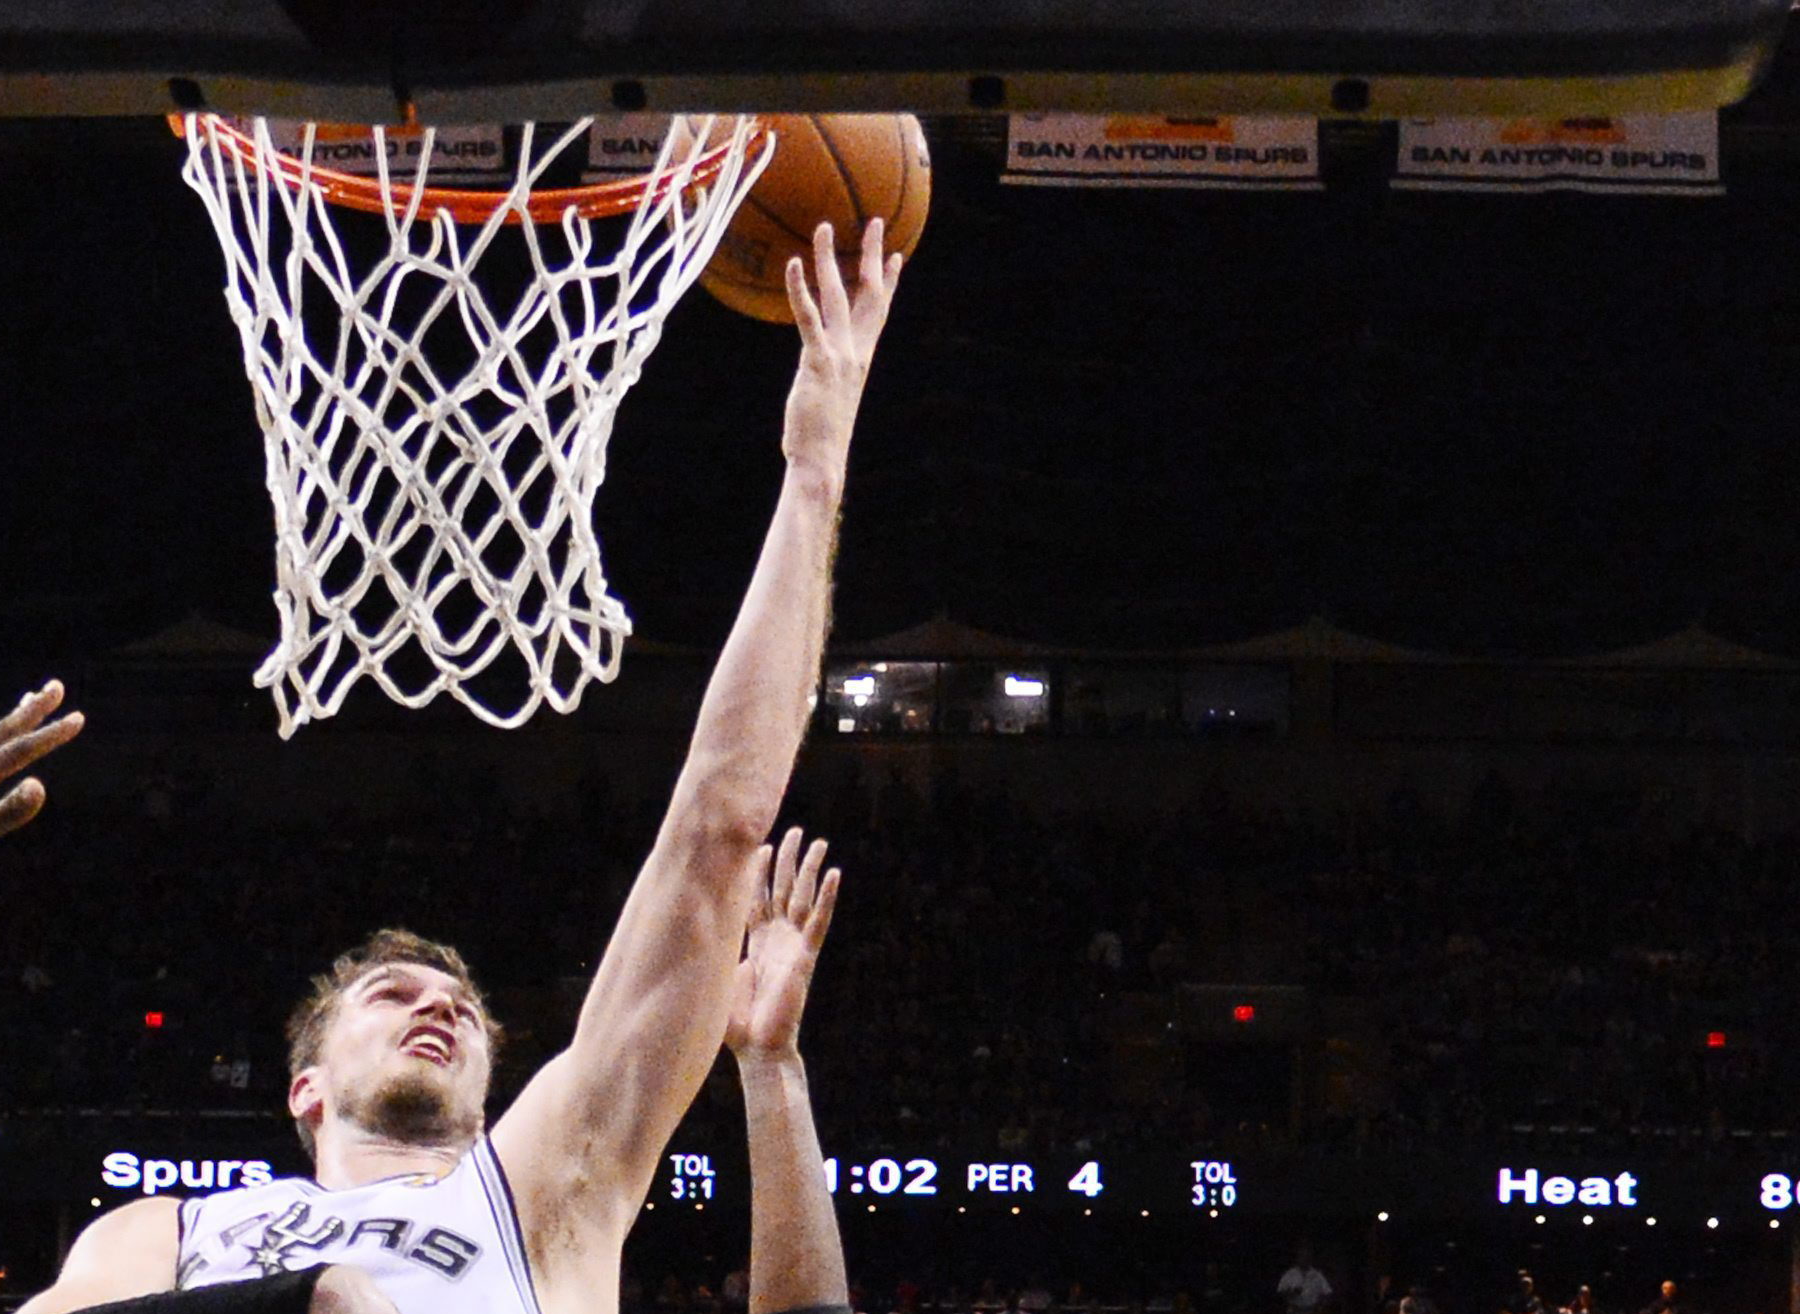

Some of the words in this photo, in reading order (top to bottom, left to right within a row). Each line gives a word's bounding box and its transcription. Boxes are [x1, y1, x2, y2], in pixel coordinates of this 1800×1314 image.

[1016, 141, 1075, 159] SAN
[1082, 143, 1207, 162] ANTONIO
[1214, 145, 1309, 164] SPURS
[1411, 145, 1471, 164] SAN
[1480, 146, 1603, 167] ANTONIO
[1611, 151, 1707, 170] SPURS
[102, 1152, 273, 1195] Spurs
[670, 1154, 715, 1177] TOL
[822, 1158, 938, 1195] 1:02
[1189, 1161, 1237, 1184] TOL
[670, 1178, 715, 1199] 3:1
[967, 1164, 1035, 1193] PER
[1067, 1161, 1104, 1198] 4
[1498, 1167, 1638, 1206] Heat
[1760, 1173, 1800, 1210] 8
[1190, 1184, 1237, 1207] 3:0
